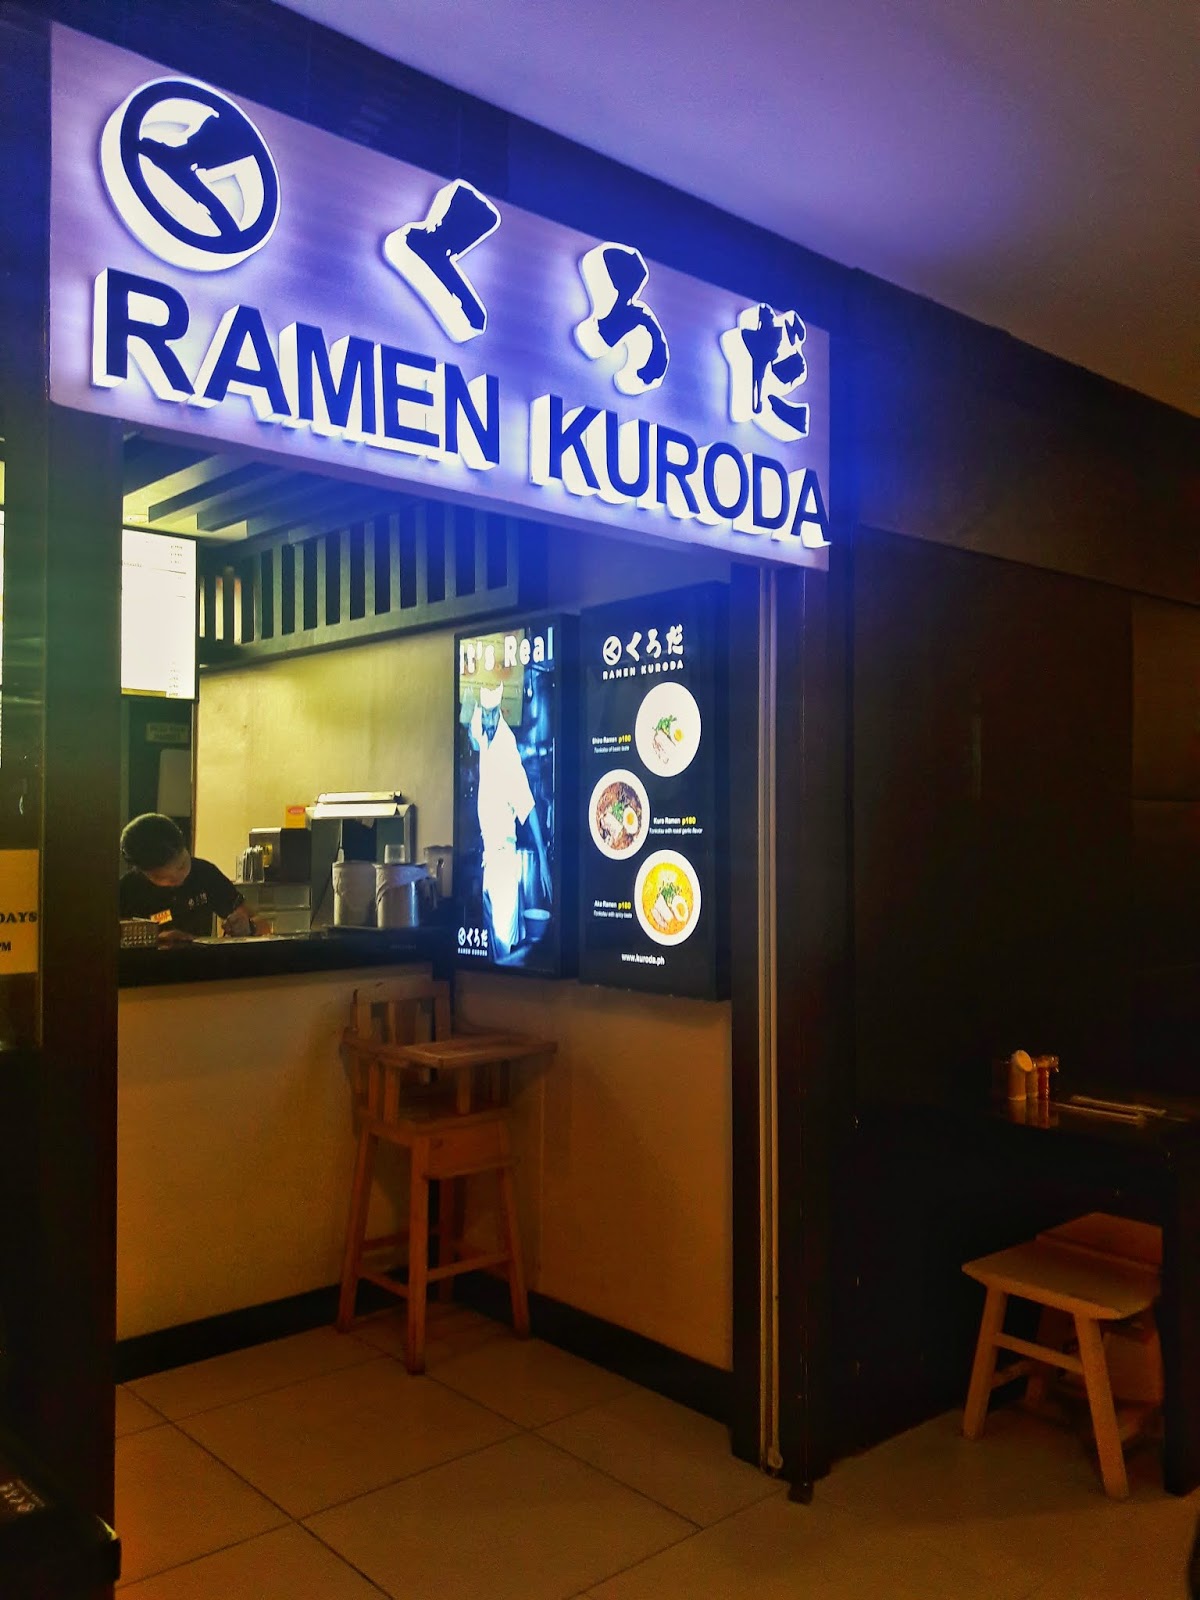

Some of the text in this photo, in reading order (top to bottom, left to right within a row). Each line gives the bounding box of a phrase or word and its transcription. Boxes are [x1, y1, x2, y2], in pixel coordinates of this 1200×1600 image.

[92, 268, 833, 550] RAMEN KURODA
[459, 627, 554, 675] It's Real
[602, 659, 684, 681] RAMEN KURODA
[603, 736, 617, 744] Ramen
[665, 816, 681, 825] Ramen
[602, 900, 618, 908] Ramen
[621, 953, 665, 966] www.kuroda.ph
